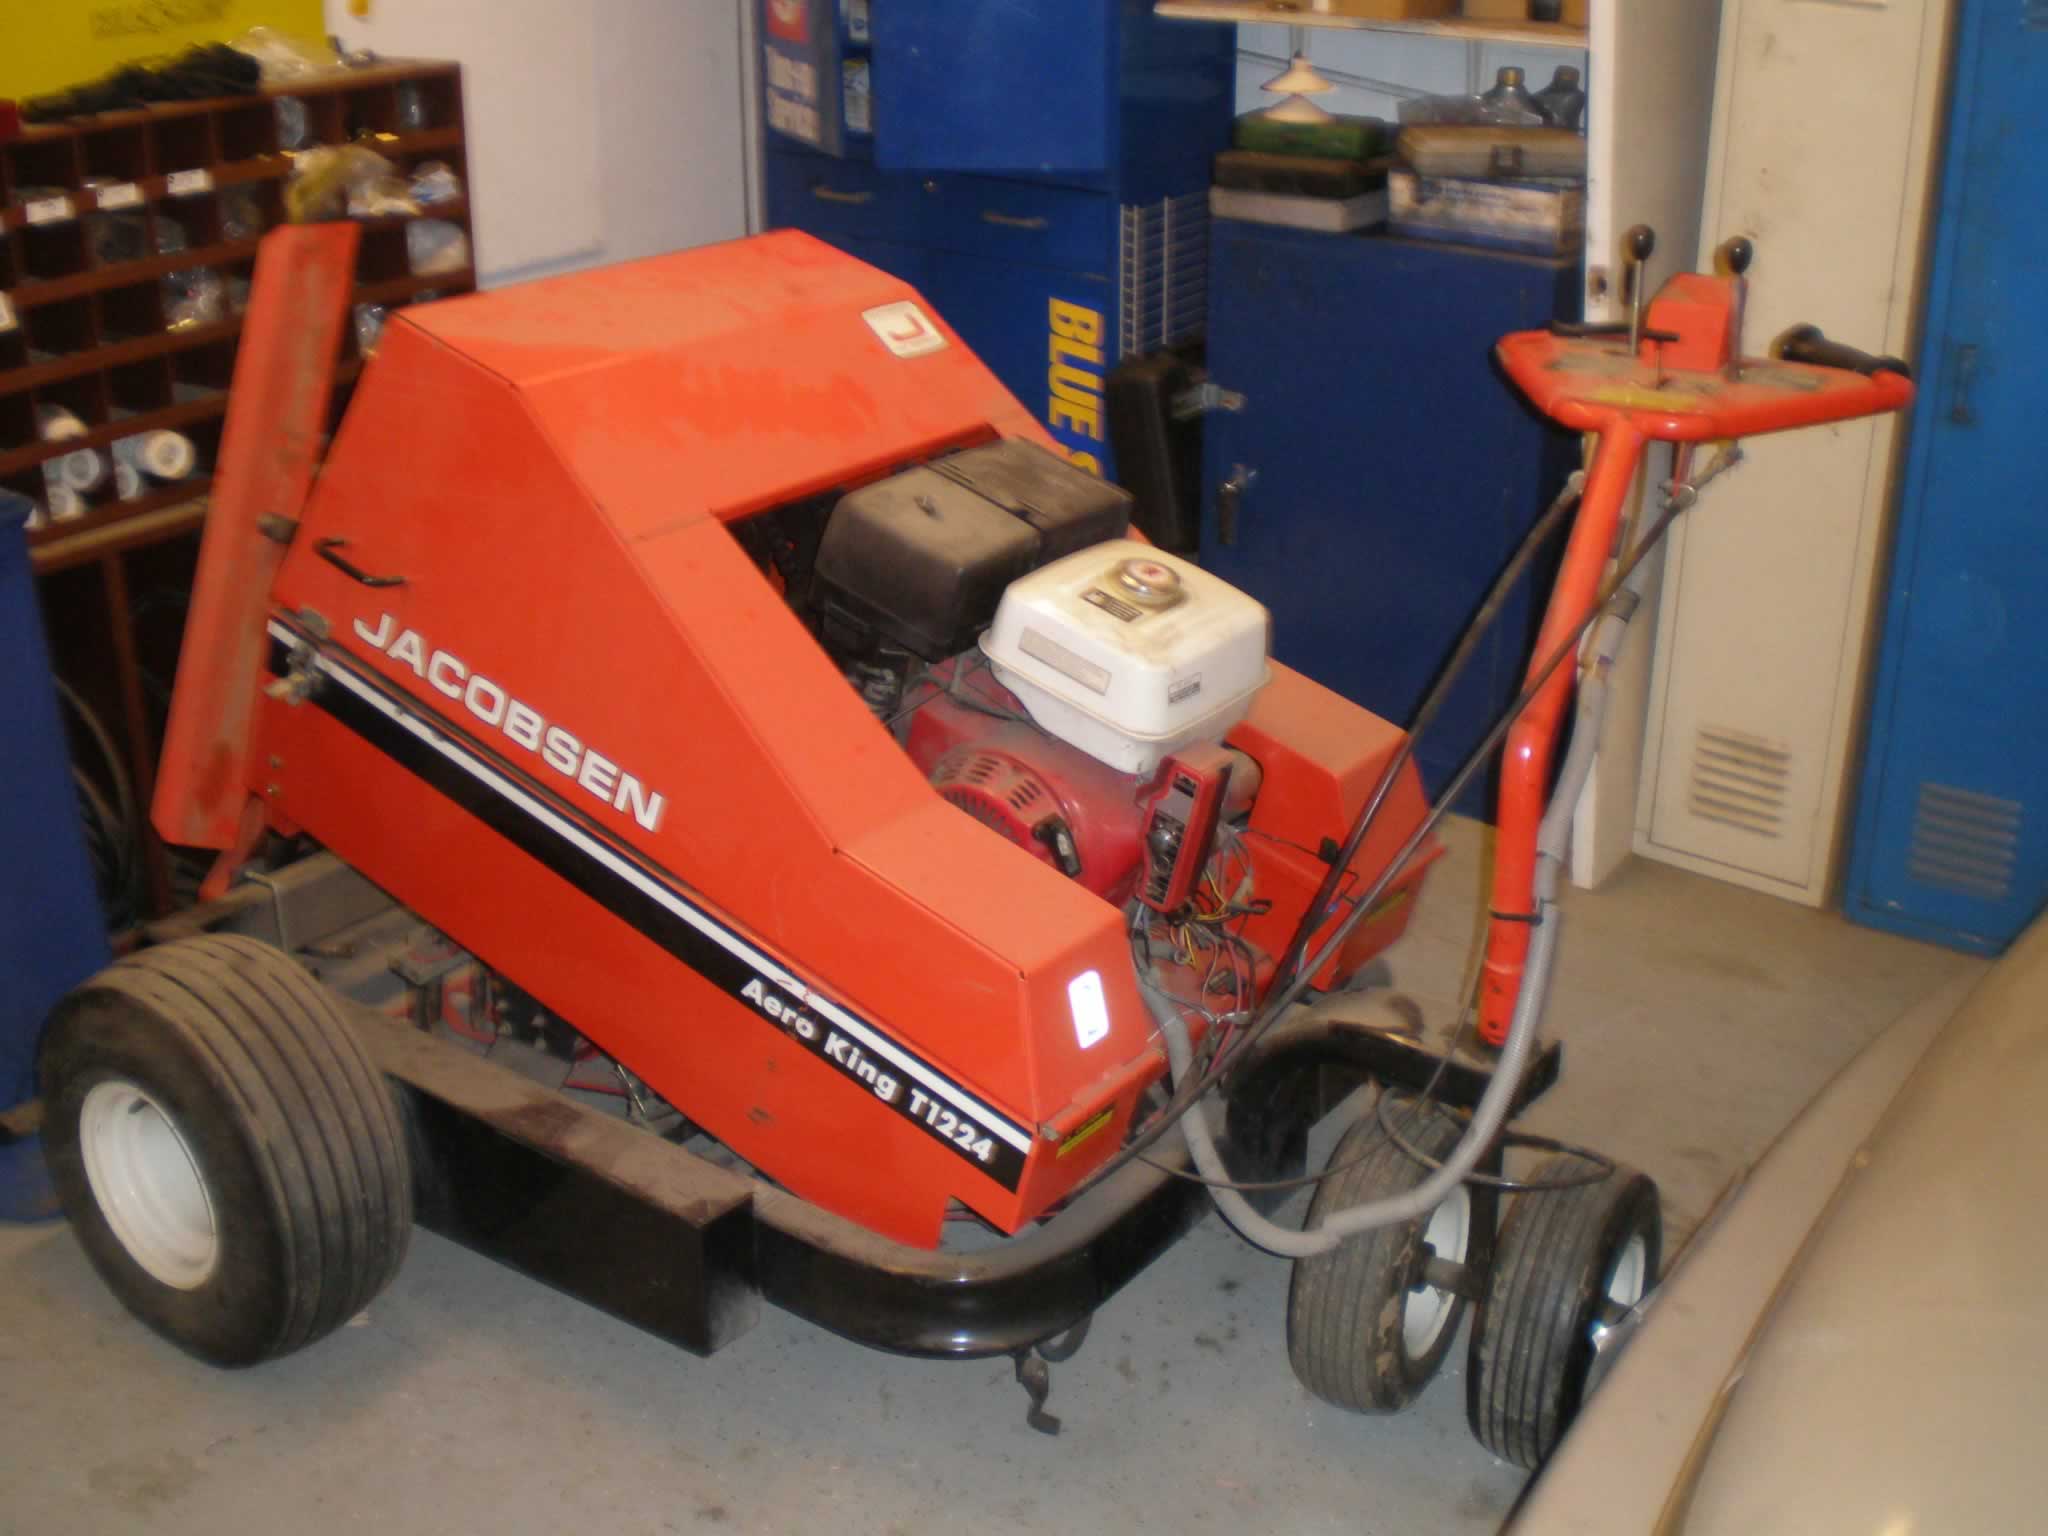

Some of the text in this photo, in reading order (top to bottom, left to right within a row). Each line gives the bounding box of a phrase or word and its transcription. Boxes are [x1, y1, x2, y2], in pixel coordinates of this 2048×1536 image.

[1048, 296, 1104, 442] BLUE
[352, 612, 664, 833] JACOBSEN
[740, 978, 816, 1041] Aero
[823, 1031, 899, 1103] King
[909, 1086, 996, 1162] T1224
